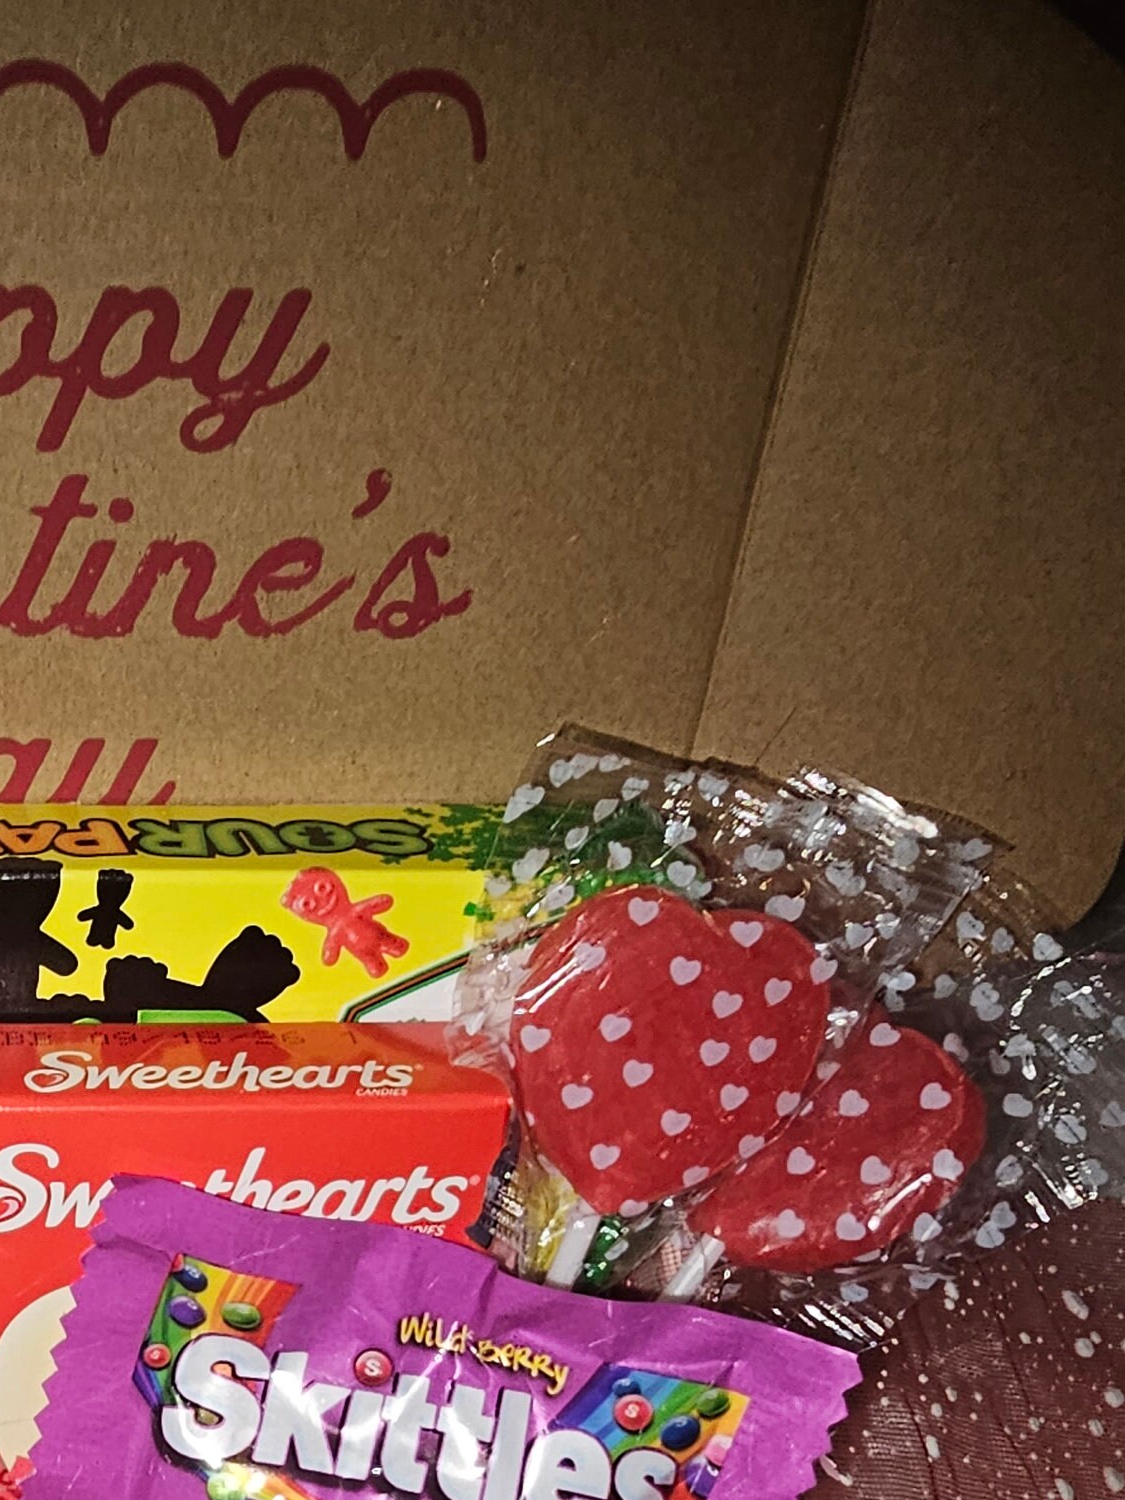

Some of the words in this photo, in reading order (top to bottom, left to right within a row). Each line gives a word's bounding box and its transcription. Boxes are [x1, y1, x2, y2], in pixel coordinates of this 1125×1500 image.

[135, 818, 435, 857] SOUR
[24, 1050, 414, 1093] Sweethearts
[355, 1087, 409, 1097] CANDIES
